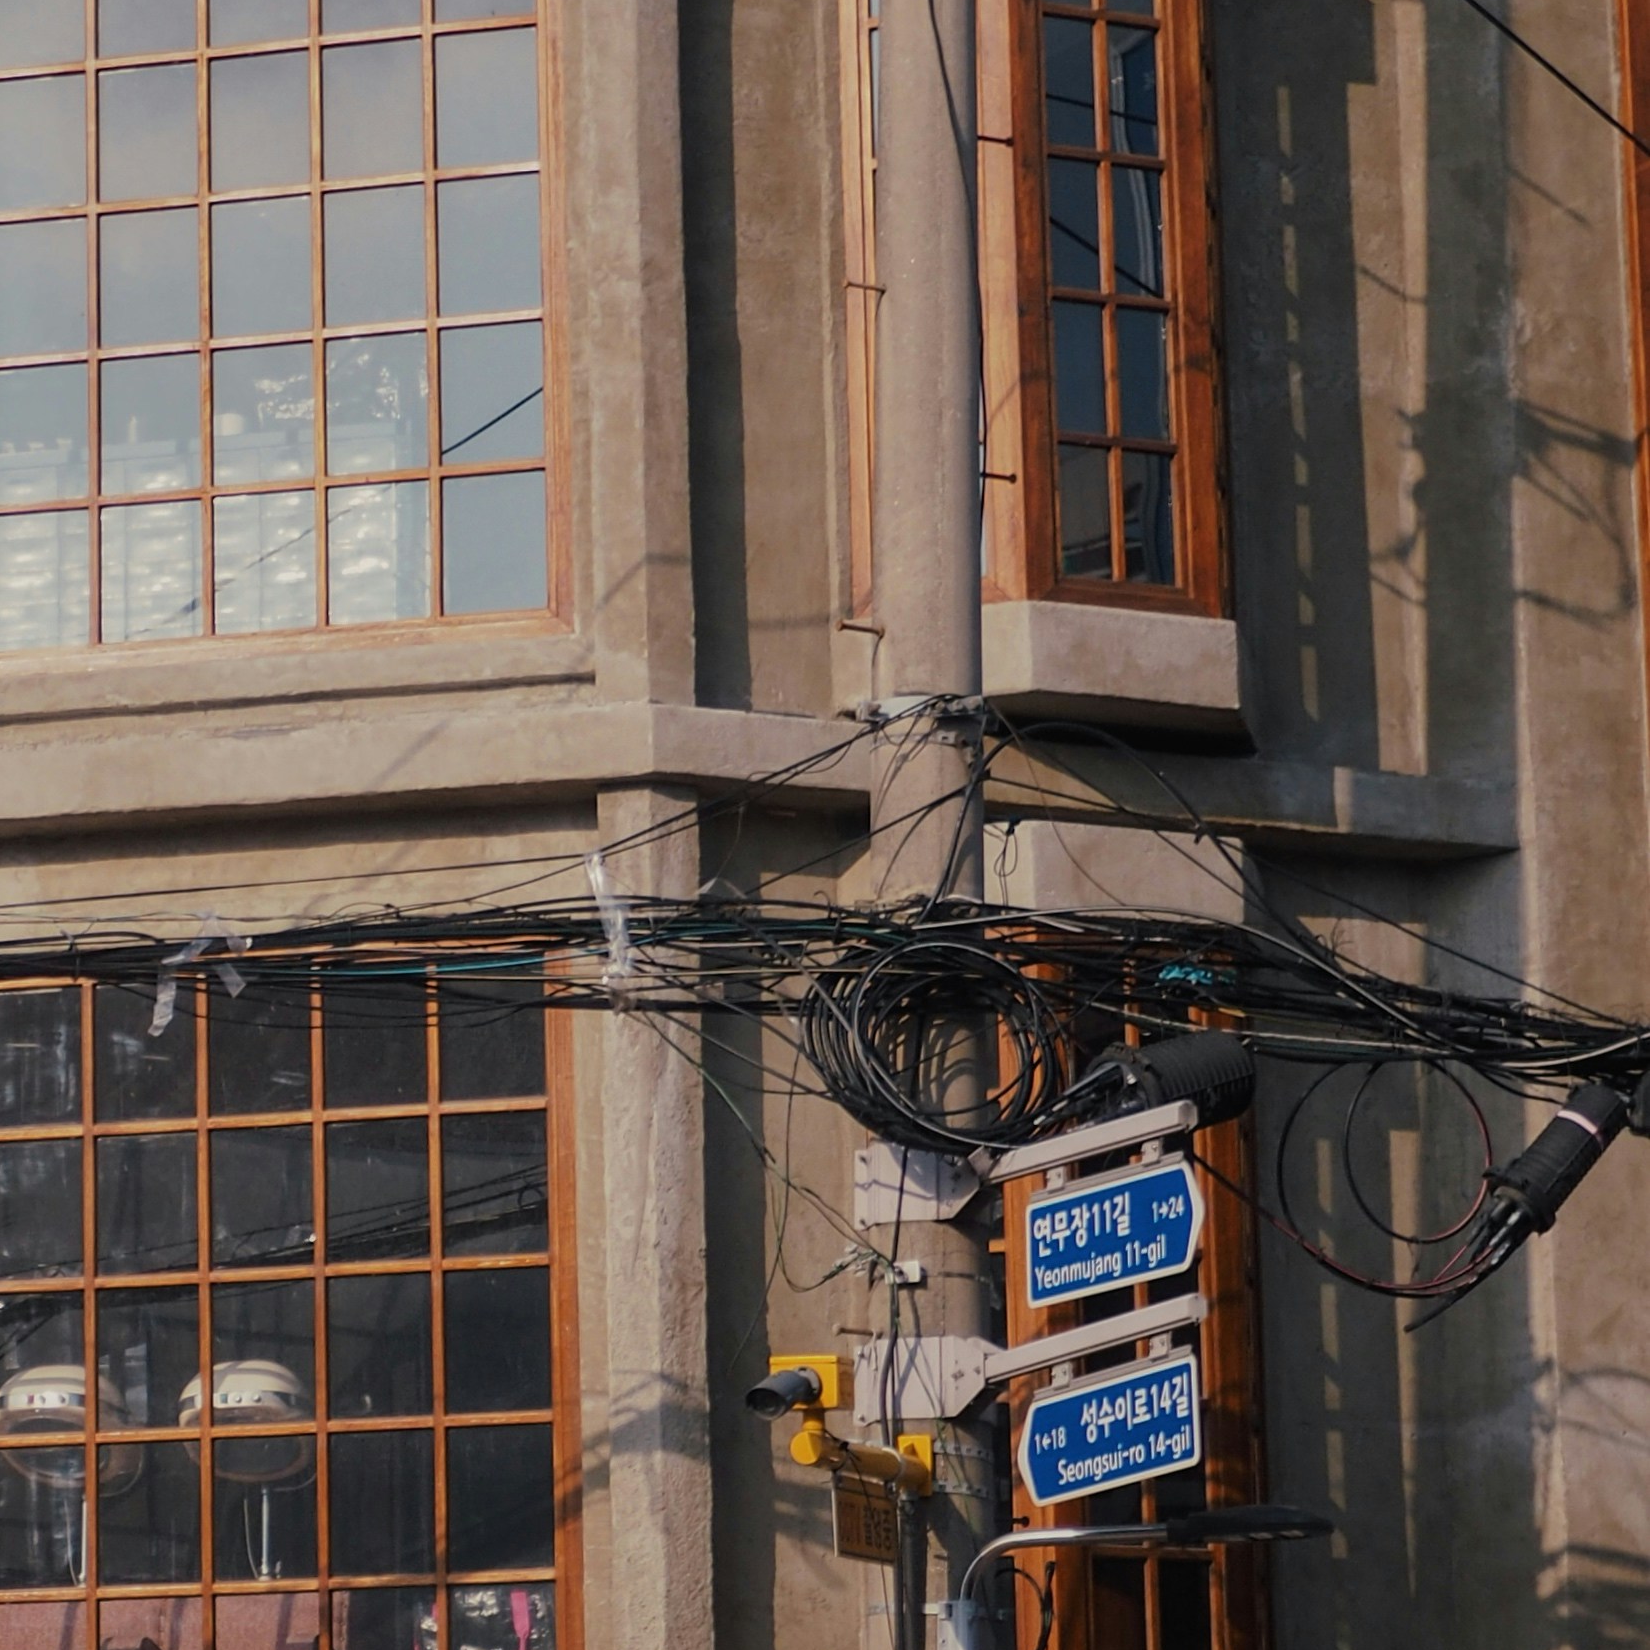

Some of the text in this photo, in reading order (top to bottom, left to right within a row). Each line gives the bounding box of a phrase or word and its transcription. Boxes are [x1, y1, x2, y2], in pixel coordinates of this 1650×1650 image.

[1033, 1192, 1131, 1257] 연무장11길
[1034, 1234, 1166, 1290] Yeonmujang 11-gil
[1080, 1372, 1189, 1443] 성수이로14길
[1058, 1425, 1190, 1486] Seongsui-ro 14-gil
